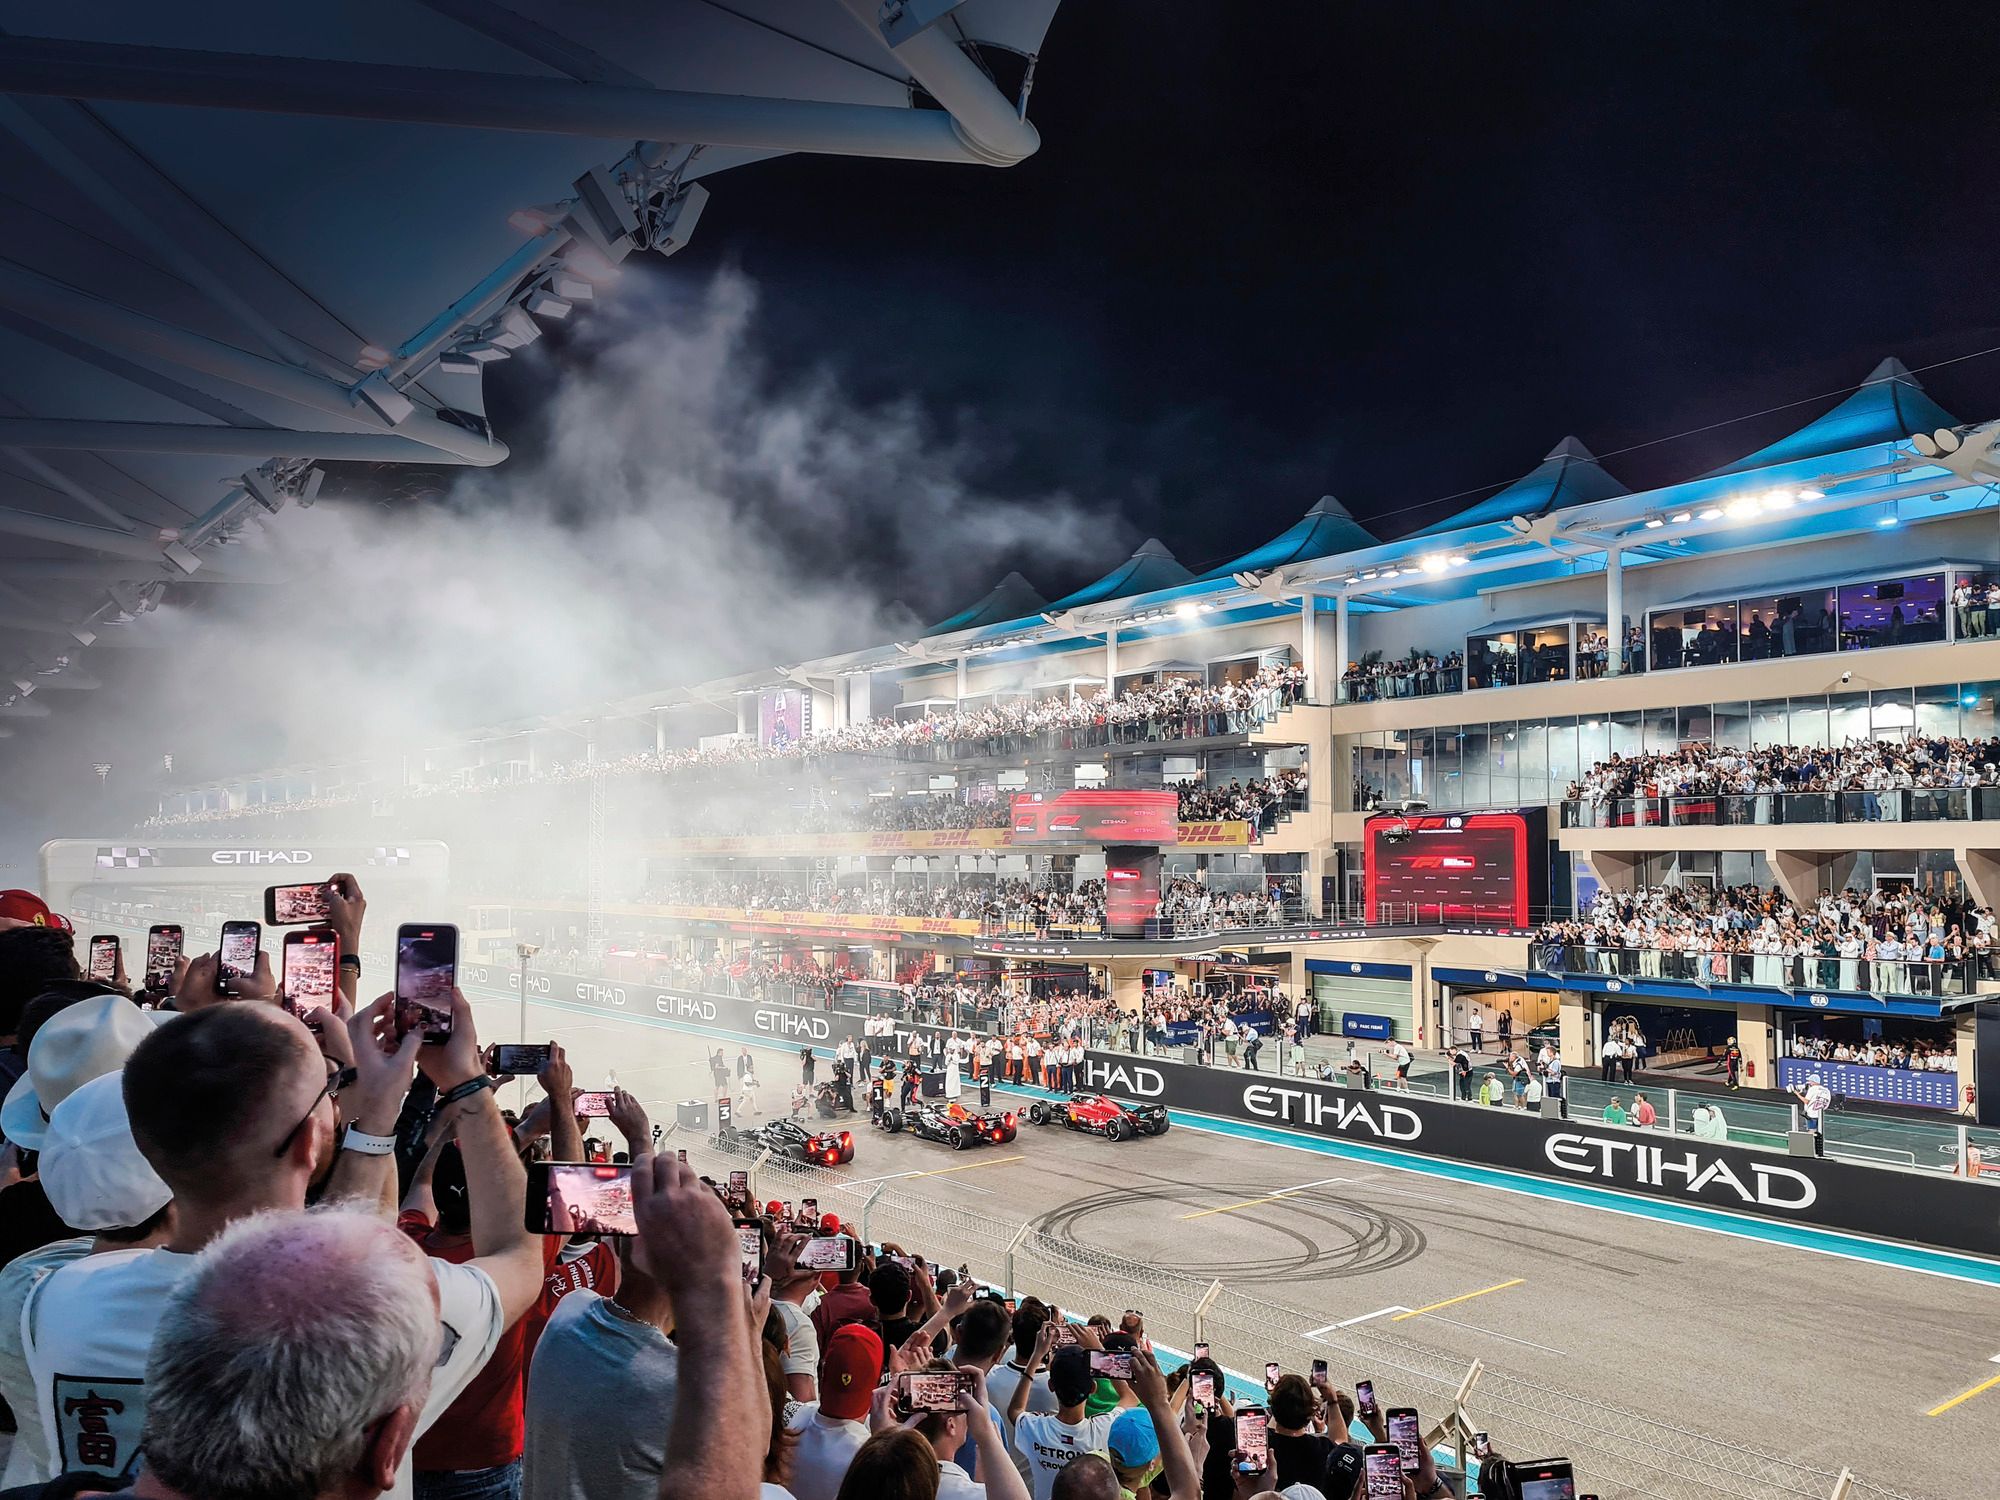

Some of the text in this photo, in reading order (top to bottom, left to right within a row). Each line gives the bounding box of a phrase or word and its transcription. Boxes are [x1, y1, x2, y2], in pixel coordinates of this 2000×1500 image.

[872, 832, 906, 847] DHL
[933, 831, 971, 846] DHL
[1178, 825, 1225, 842] DHL
[211, 850, 313, 864] ETIHAD
[872, 918, 898, 929] DHL
[922, 920, 951, 931] DHL
[509, 973, 551, 993] ETHAD
[576, 982, 626, 1006] ETIHAD
[656, 994, 717, 1021] ETIHAD
[755, 1009, 831, 1040] ETIHAD
[980, 1076, 989, 1088] 2
[1083, 1059, 1165, 1097] IHAD
[874, 1088, 882, 1101] 1
[720, 1106, 730, 1121] 3
[1243, 1084, 1423, 1141] ETIHAD
[1544, 1132, 1817, 1209] ETIHAD
[1033, 1442, 1085, 1461] PETRON
